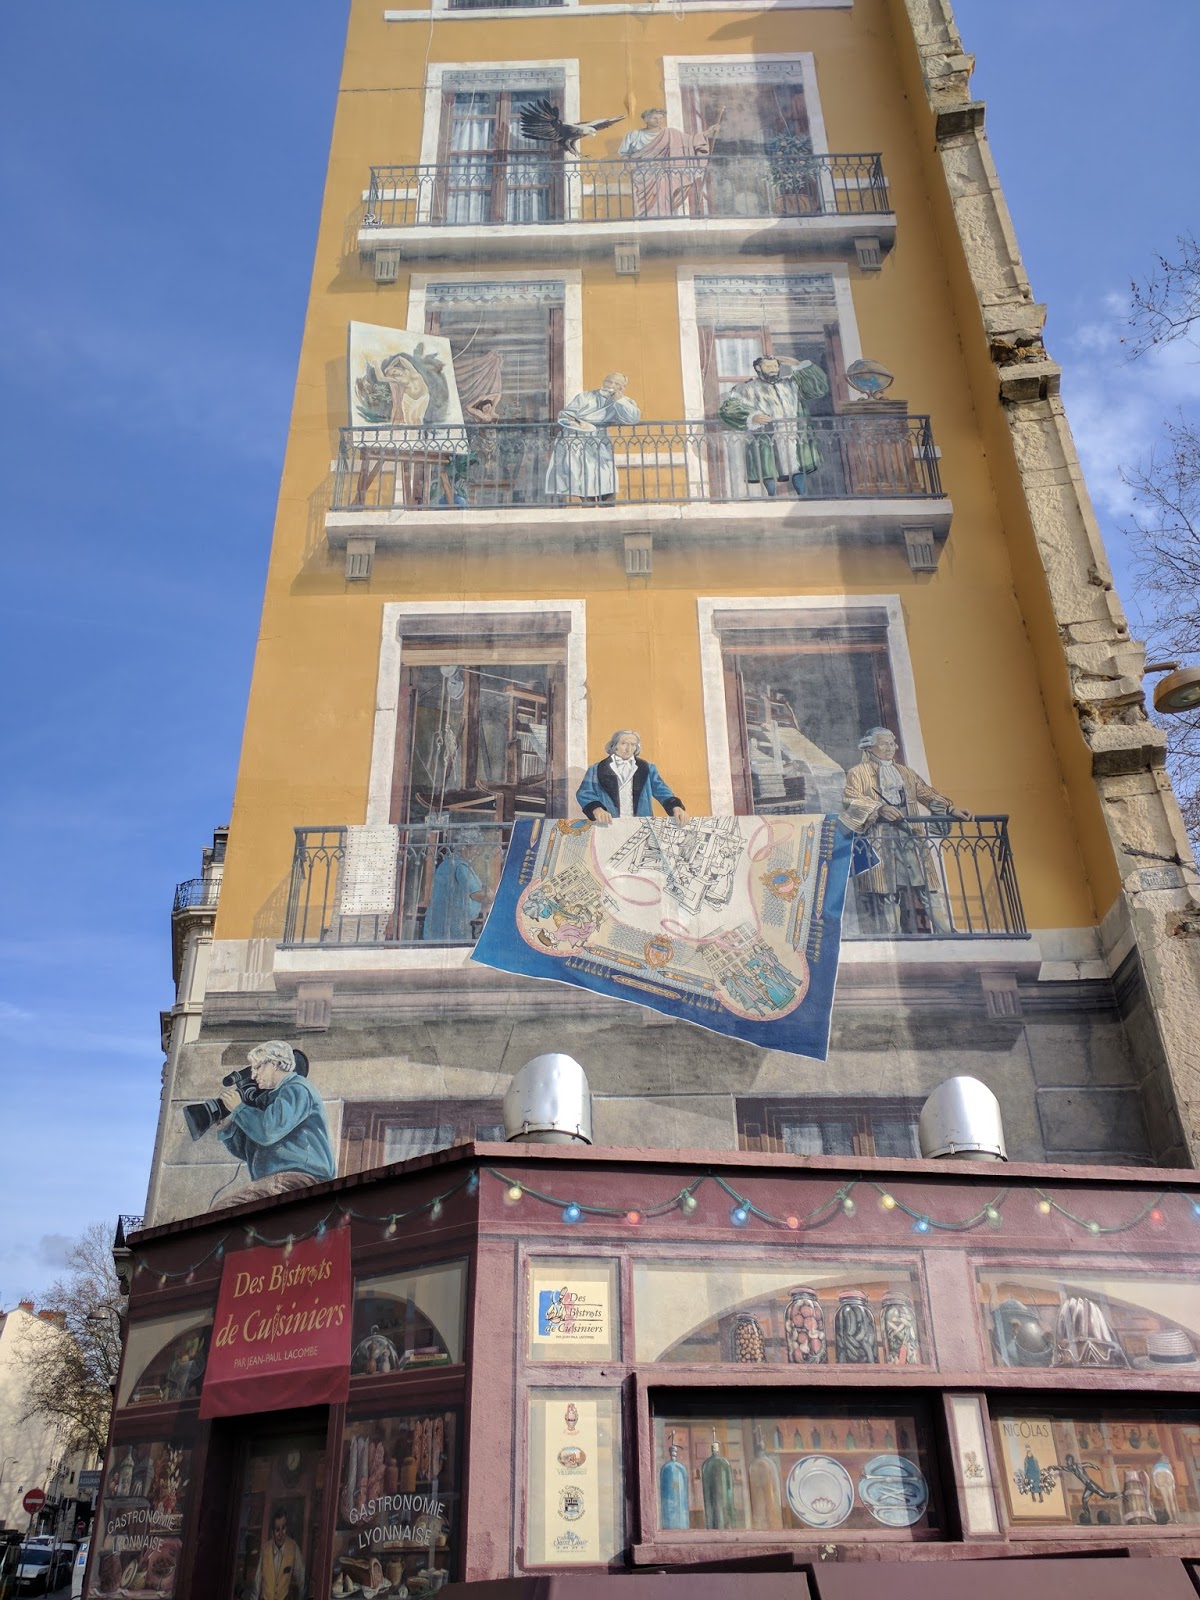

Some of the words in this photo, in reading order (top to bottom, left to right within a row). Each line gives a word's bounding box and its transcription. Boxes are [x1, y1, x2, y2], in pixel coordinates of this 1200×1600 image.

[233, 1272, 265, 1298] Des
[268, 1258, 332, 1295] Bistrots
[569, 1292, 586, 1302] Des
[215, 1314, 239, 1347] de
[243, 1297, 345, 1344] Cuisiniers
[569, 1307, 602, 1318] Bistrots
[545, 1323, 555, 1333] de
[558, 1323, 603, 1333] Cuisiniers
[233, 1357, 246, 1368] PAR
[246, 1353, 282, 1369] JEAN-PAUL
[284, 1346, 318, 1360] LACOMBE
[1002, 1420, 1049, 1438] NICOLAS
[349, 1494, 445, 1524] GASTRONOMIE
[107, 1509, 175, 1531] GASTRONOMIE
[112, 1535, 164, 1554] LYONNAISE
[358, 1524, 432, 1549] LYONNAISE
[82, 1543, 88, 1551] P
